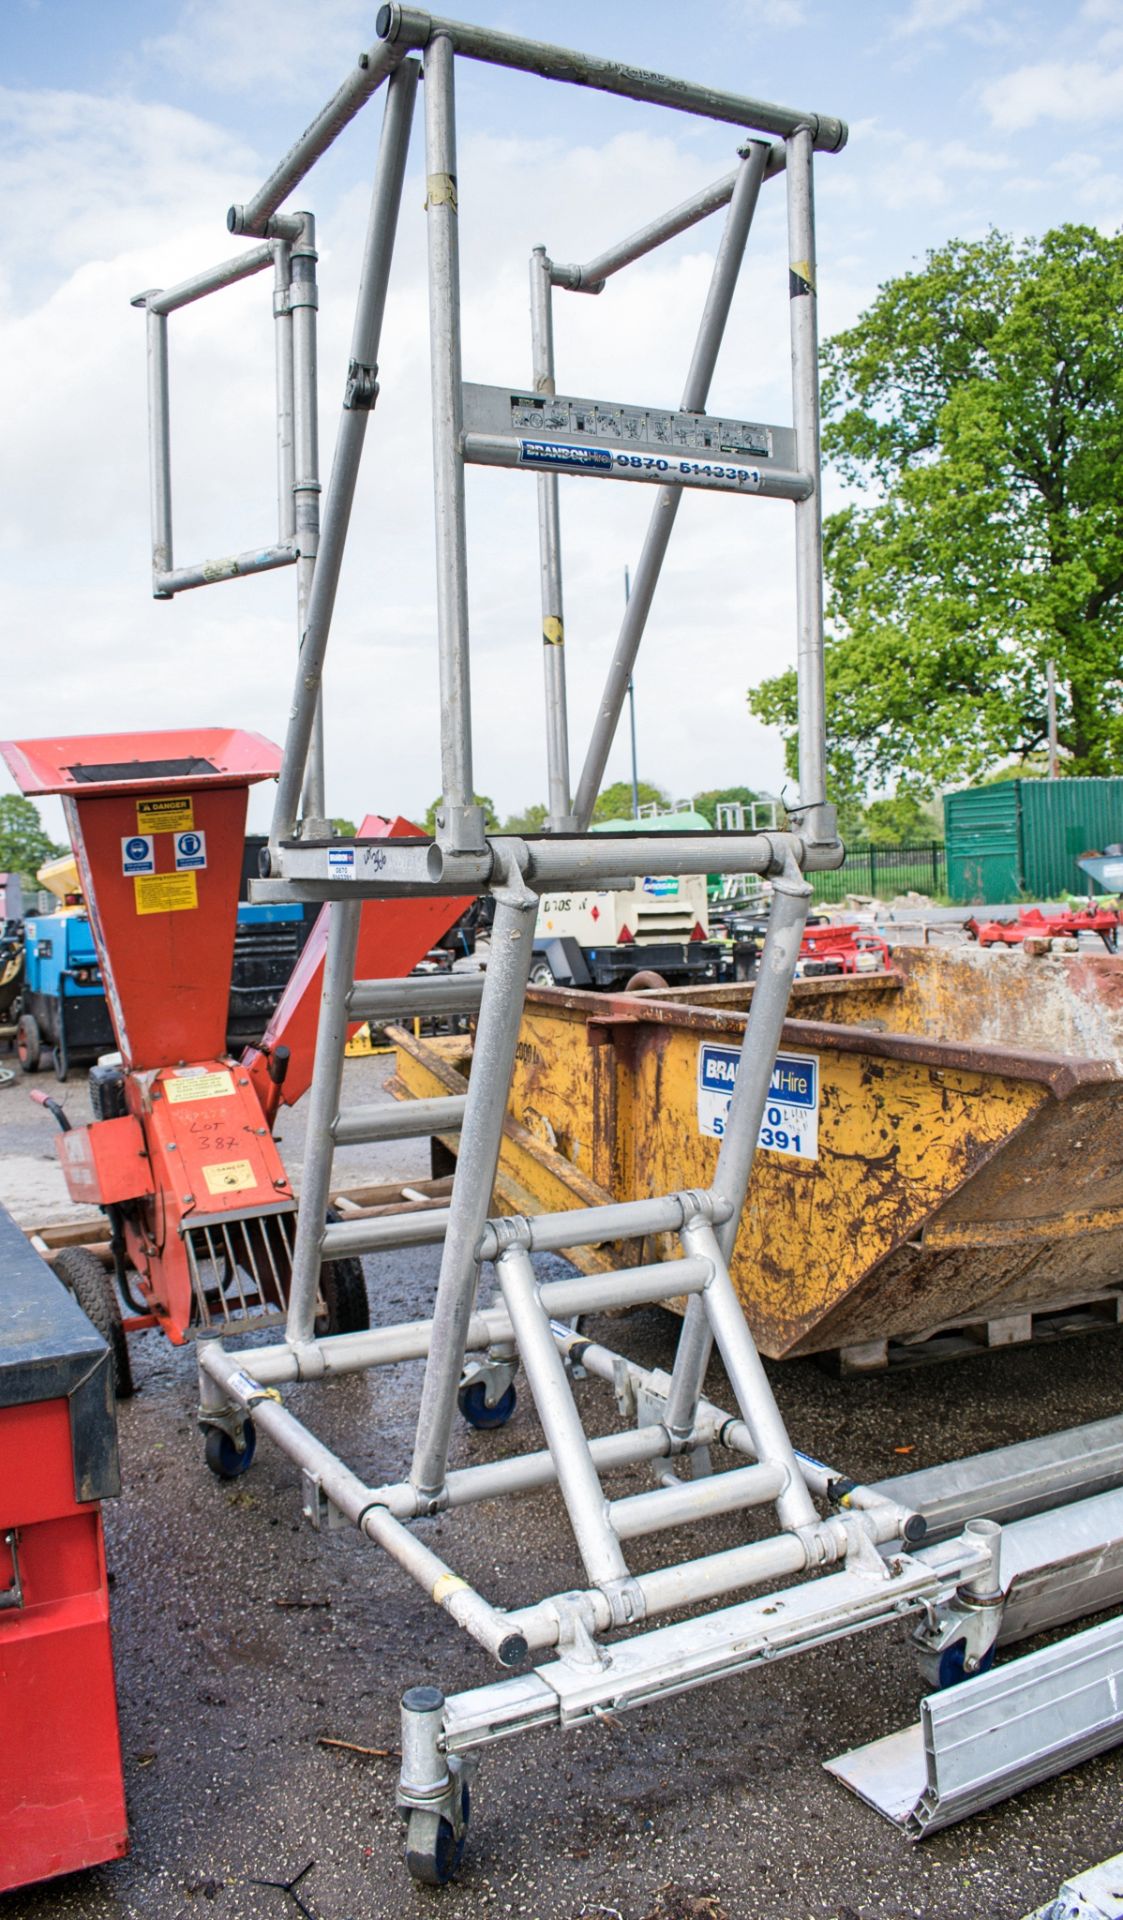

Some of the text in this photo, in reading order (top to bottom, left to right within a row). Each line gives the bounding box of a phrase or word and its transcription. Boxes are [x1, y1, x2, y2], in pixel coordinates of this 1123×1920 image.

[616, 454, 669, 472] 0870
[679, 462, 759, 482] 5143391
[152, 801, 187, 811] DANGER
[706, 1058, 808, 1094] BRANHire
[190, 1122, 224, 1133] LOT
[199, 1136, 240, 1150] 387
